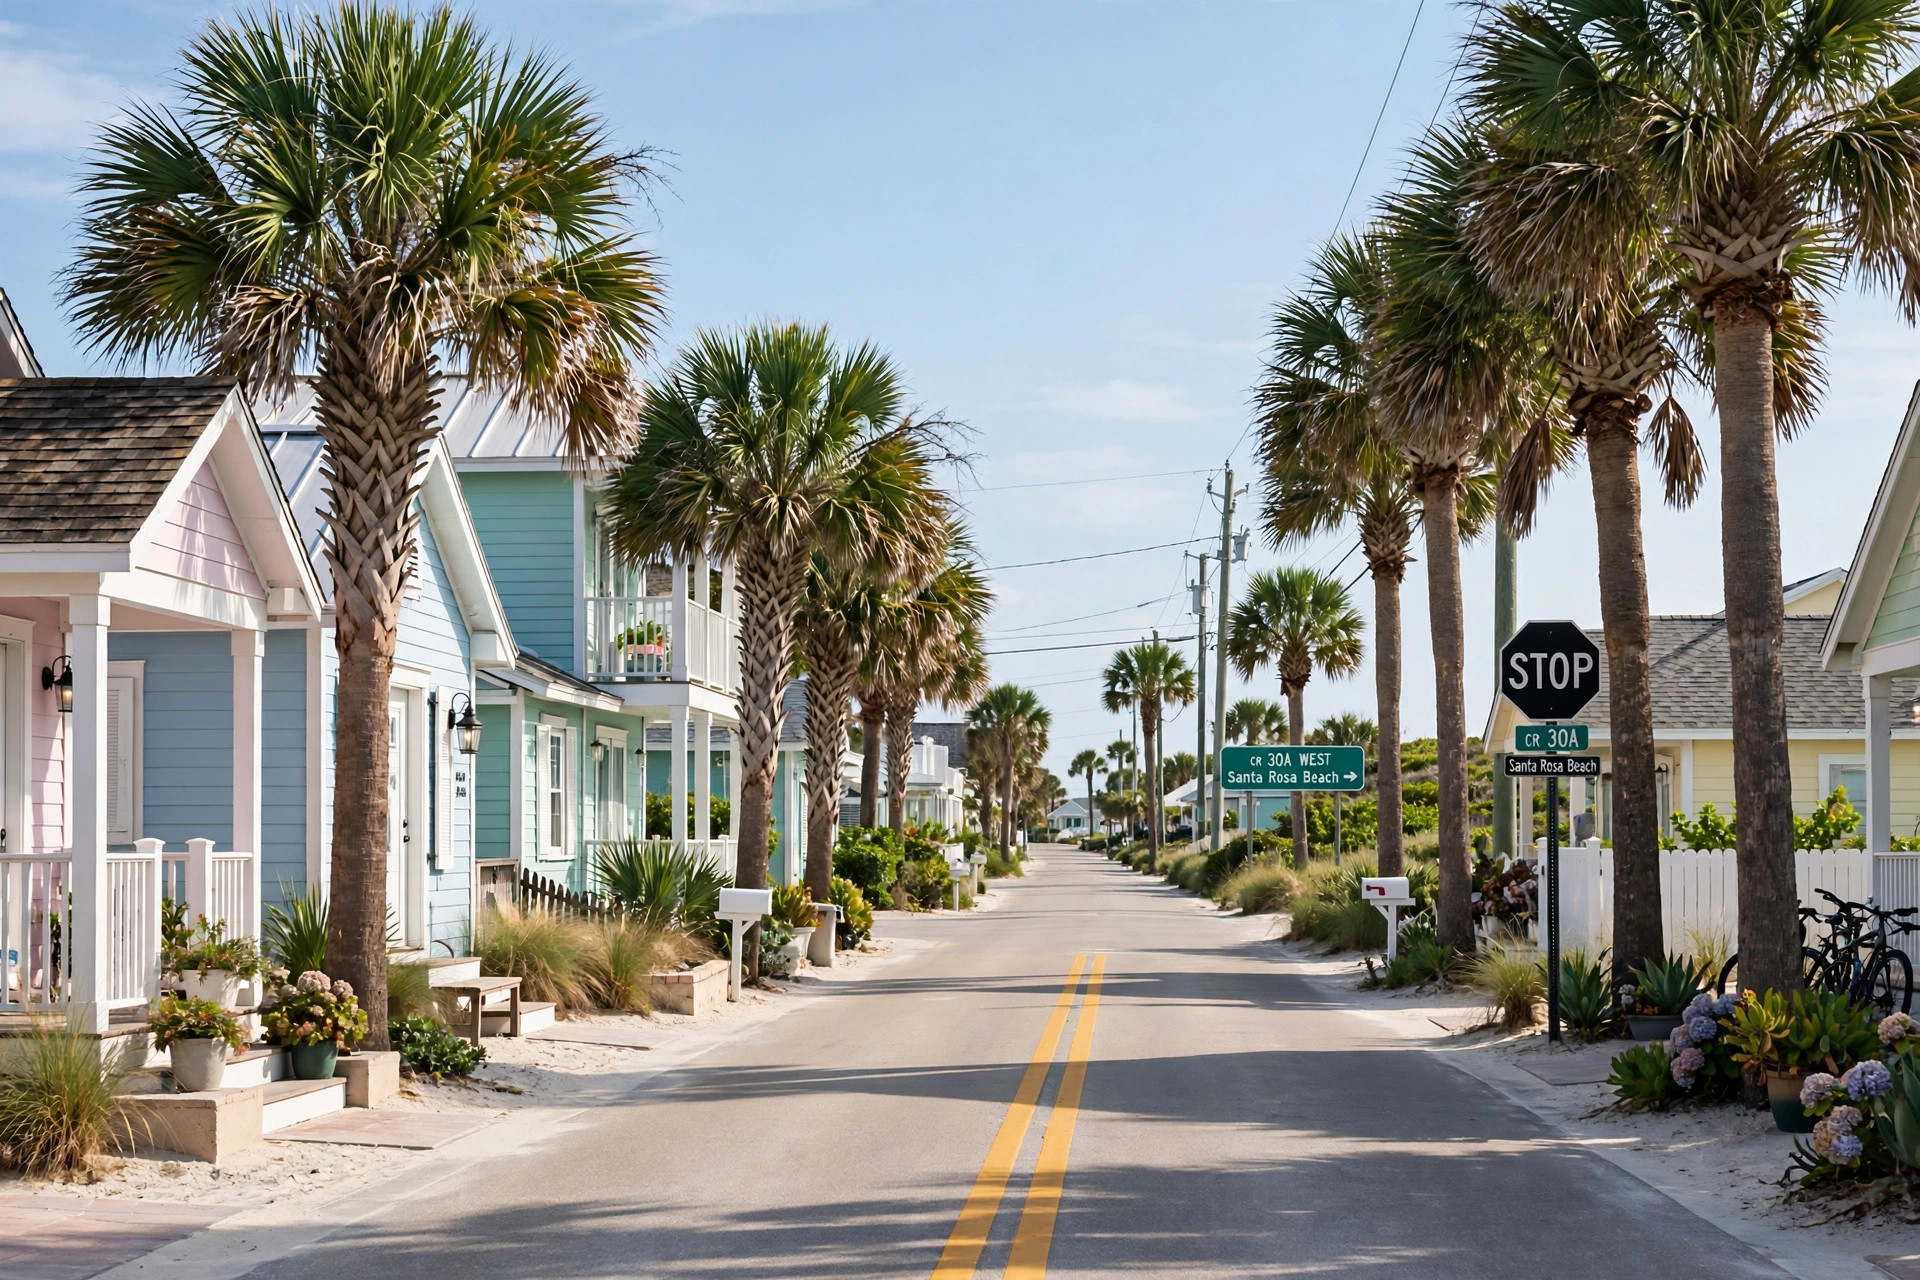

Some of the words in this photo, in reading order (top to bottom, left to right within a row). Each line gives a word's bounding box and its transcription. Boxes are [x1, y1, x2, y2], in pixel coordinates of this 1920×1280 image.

[1508, 652, 1593, 690] STOP
[1525, 733, 1540, 747] CR
[1547, 728, 1579, 748] 30A
[1250, 756, 1262, 766] CR
[1267, 752, 1292, 766] 30A
[1299, 753, 1331, 766] WEST
[1509, 758, 1537, 773] Santa
[1540, 759, 1564, 773] Rosa
[1567, 758, 1597, 773] Beach
[1227, 770, 1263, 784] Santa
[1268, 770, 1297, 784] Rosa
[1303, 770, 1339, 784] Beach
